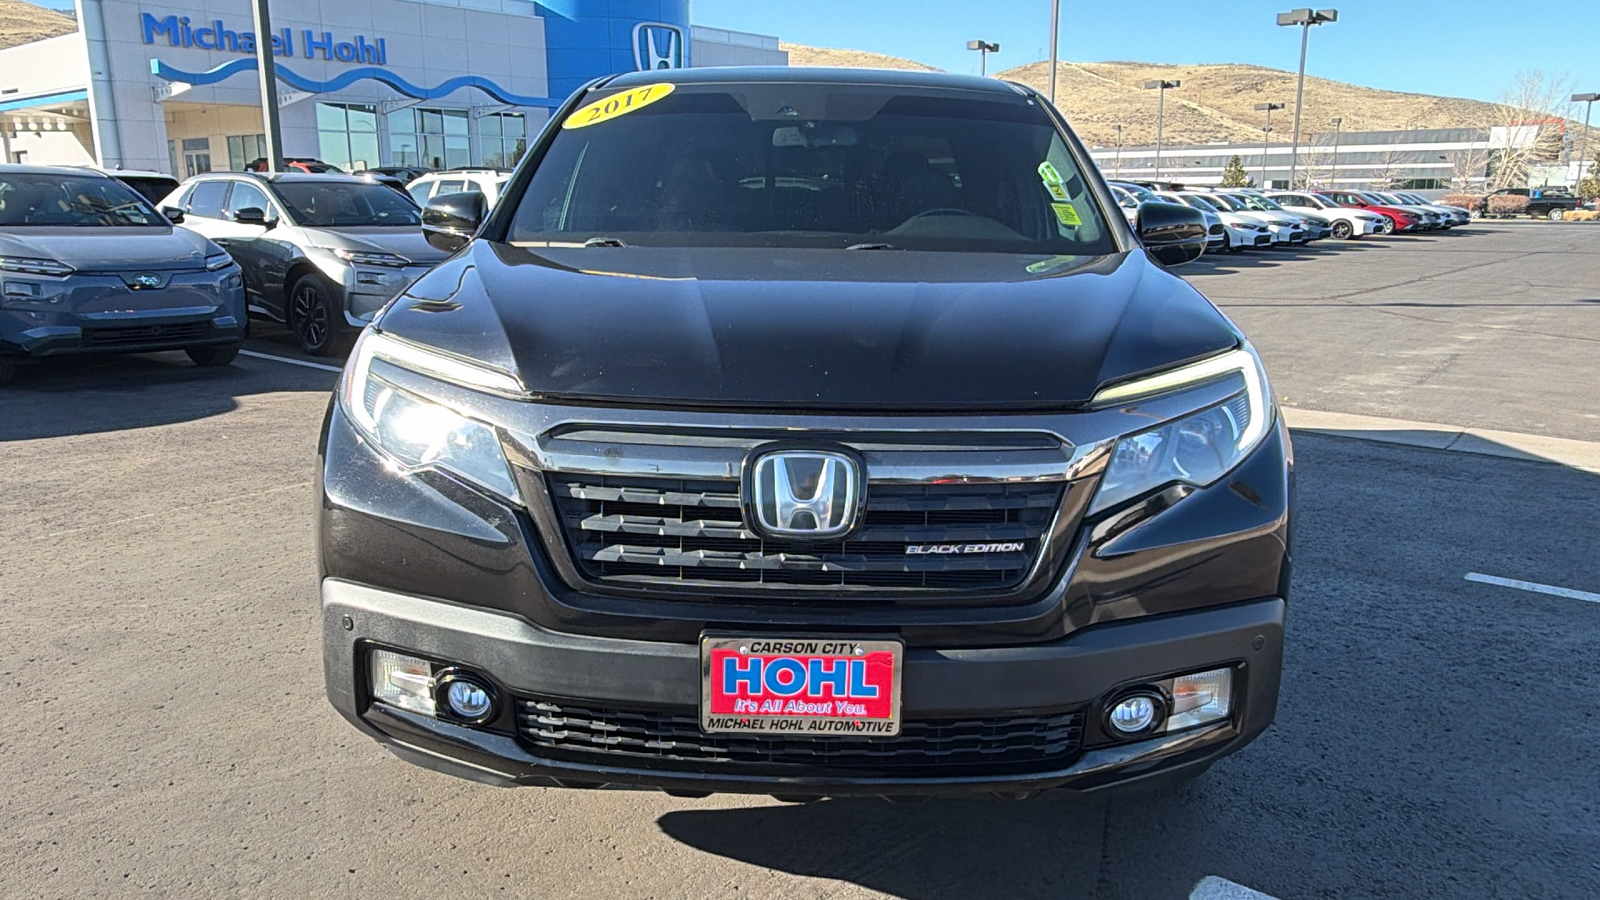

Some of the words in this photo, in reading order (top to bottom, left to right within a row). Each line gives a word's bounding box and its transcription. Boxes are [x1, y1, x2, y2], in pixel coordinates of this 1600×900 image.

[303, 29, 387, 65] Hohl
[587, 87, 653, 122] 2017
[905, 544, 963, 554] BLACK
[963, 543, 1024, 553] EDITION
[750, 642, 817, 654] CARSON
[825, 643, 859, 654] CITY
[723, 657, 879, 698] HOHL
[734, 698, 758, 712] It's
[760, 699, 782, 712] All
[784, 700, 832, 713] About
[835, 701, 867, 715] You.
[707, 718, 765, 730] MICHAEL
[769, 719, 805, 731] HOHL
[808, 720, 894, 732] AUTOMOTIVE
